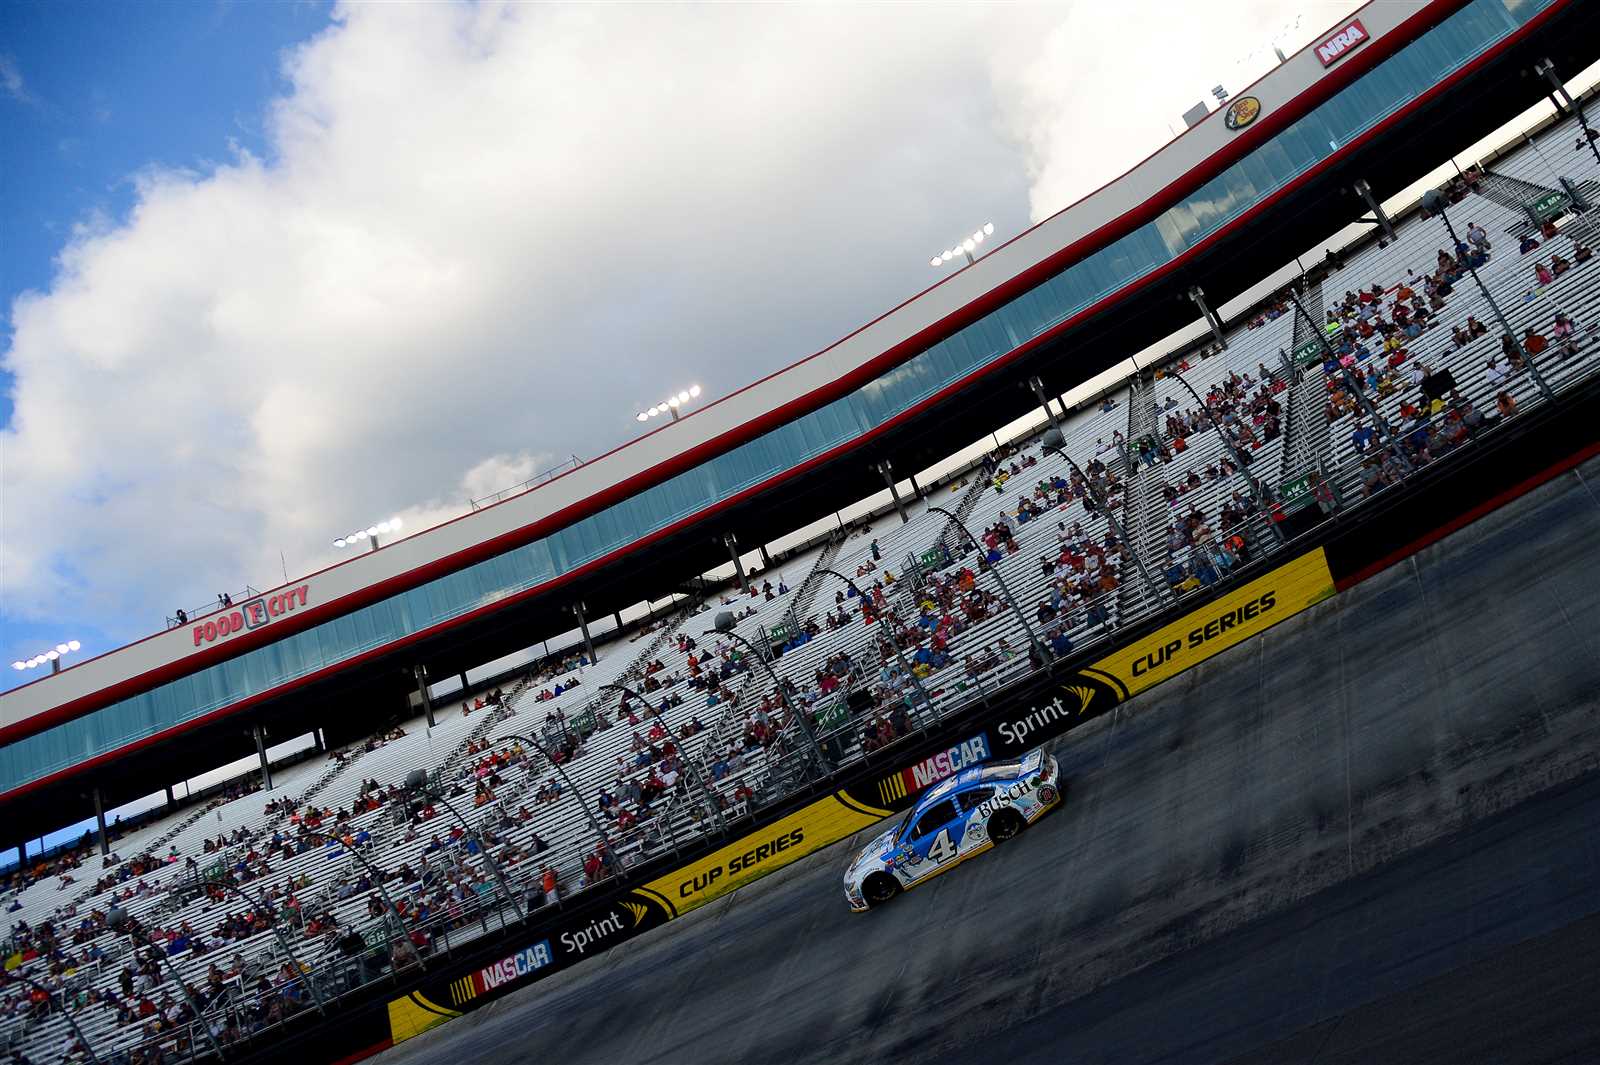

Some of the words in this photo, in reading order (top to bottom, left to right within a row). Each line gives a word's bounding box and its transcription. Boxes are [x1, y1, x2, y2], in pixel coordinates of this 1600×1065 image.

[1318, 26, 1364, 62] NRA
[193, 612, 244, 646] FOOD
[268, 585, 309, 617] CITY
[1132, 639, 1182, 677] CUP
[1188, 590, 1276, 649] SERIES
[998, 696, 1069, 744] Sprint
[911, 736, 987, 789] NASCAR
[979, 779, 1032, 819] BUSCH
[679, 866, 722, 898] CUP
[729, 827, 804, 876] SERIES
[928, 829, 957, 864] 4
[560, 911, 624, 953] Sprint
[481, 943, 549, 991] NASCAR
